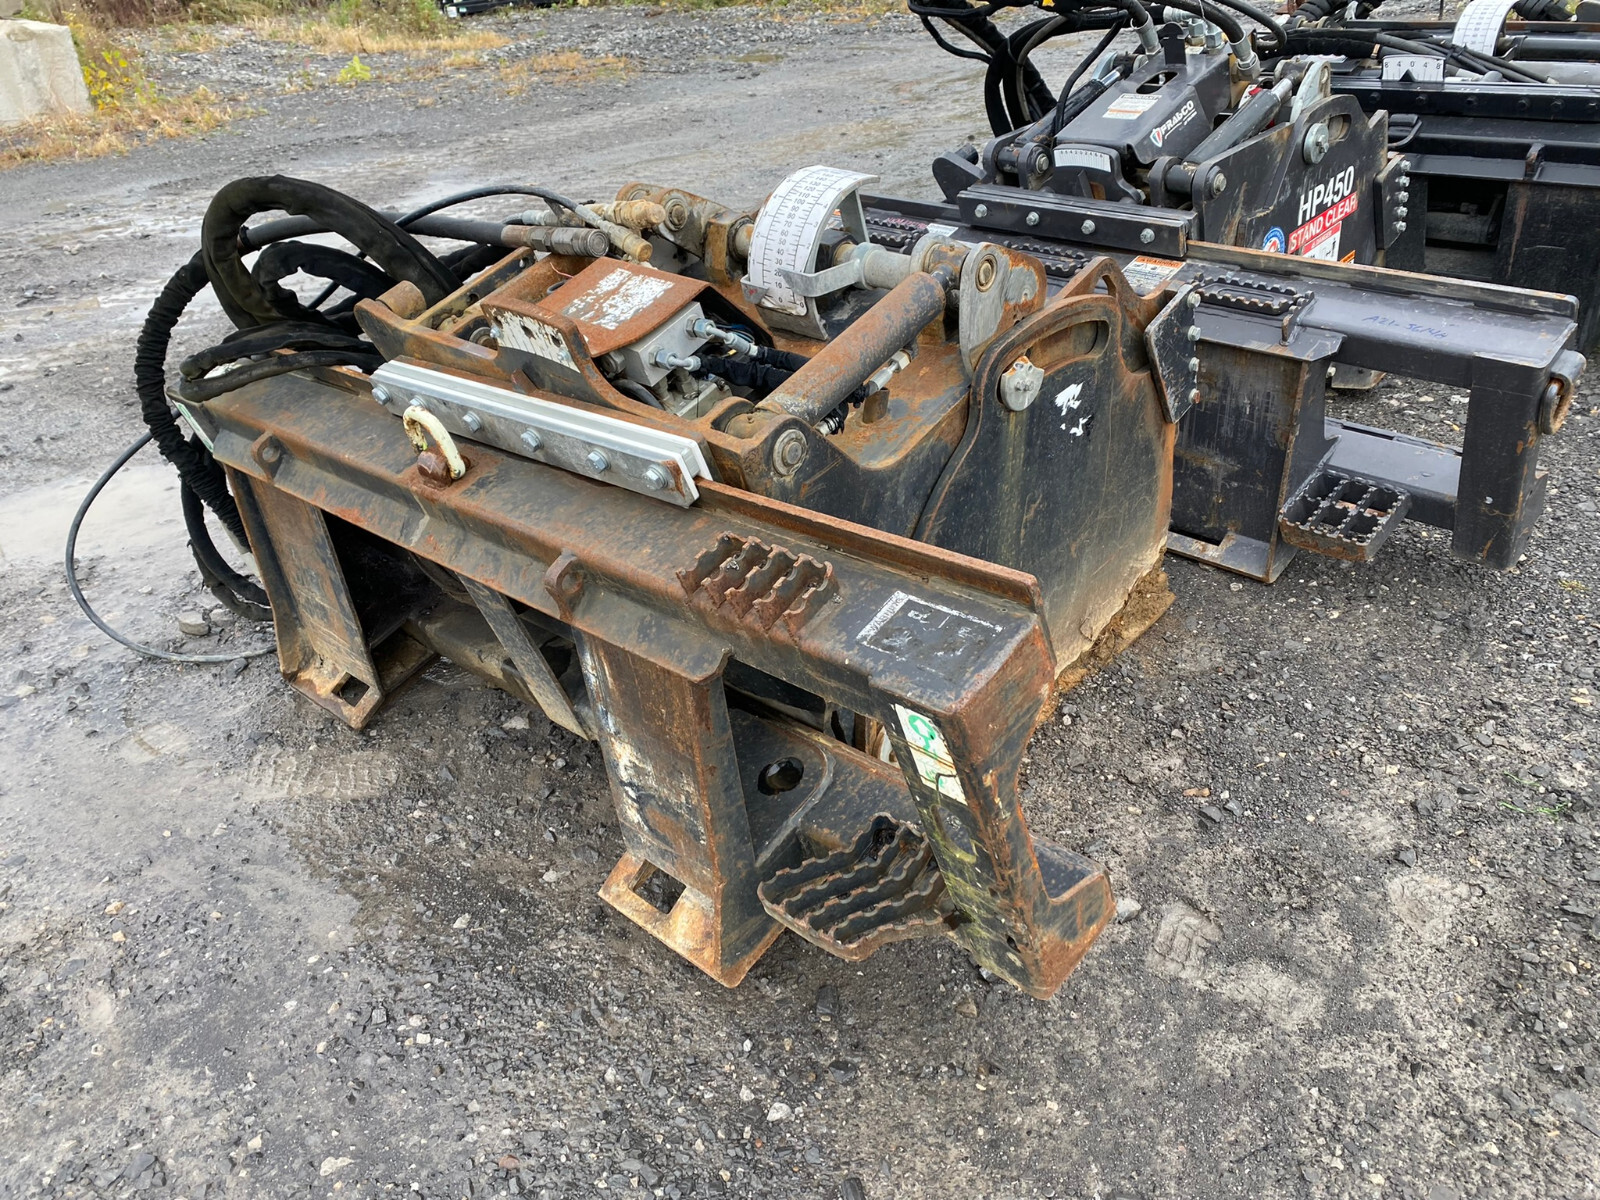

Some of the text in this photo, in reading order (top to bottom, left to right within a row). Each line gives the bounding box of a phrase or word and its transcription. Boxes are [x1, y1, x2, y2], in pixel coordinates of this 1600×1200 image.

[1290, 216, 1324, 251] STAND
[1325, 194, 1357, 227] CLEAR
[1298, 165, 1354, 226] HP450
